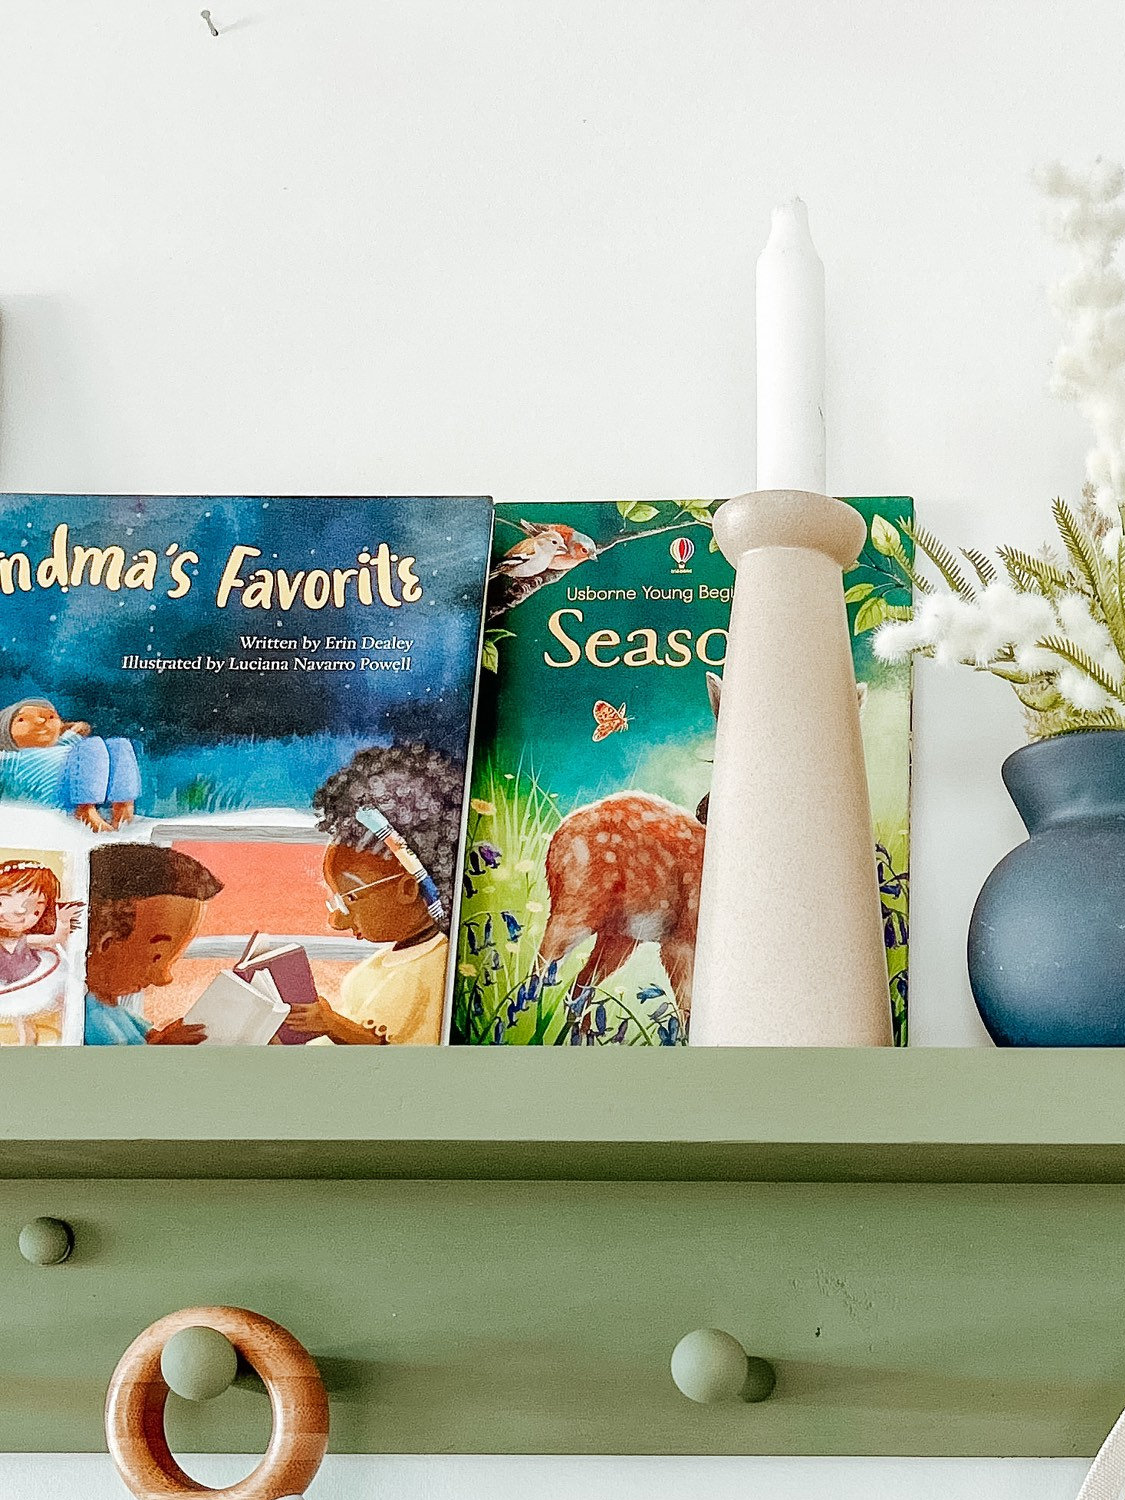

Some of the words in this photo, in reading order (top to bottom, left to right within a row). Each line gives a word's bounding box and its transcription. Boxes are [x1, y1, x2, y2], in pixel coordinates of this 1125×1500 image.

[216, 542, 424, 610] Favorite
[567, 586, 637, 601] Usborne
[642, 585, 693, 603] Young
[240, 636, 298, 650] Written
[302, 636, 321, 652] by
[325, 636, 357, 650] Erin
[361, 636, 414, 652] Dealey
[544, 608, 729, 667] Seaso
[122, 655, 201, 671] Illustrated
[206, 656, 224, 673] by
[228, 656, 289, 671] Luciana
[293, 656, 355, 671] Navarro
[360, 656, 412, 671] Powell
